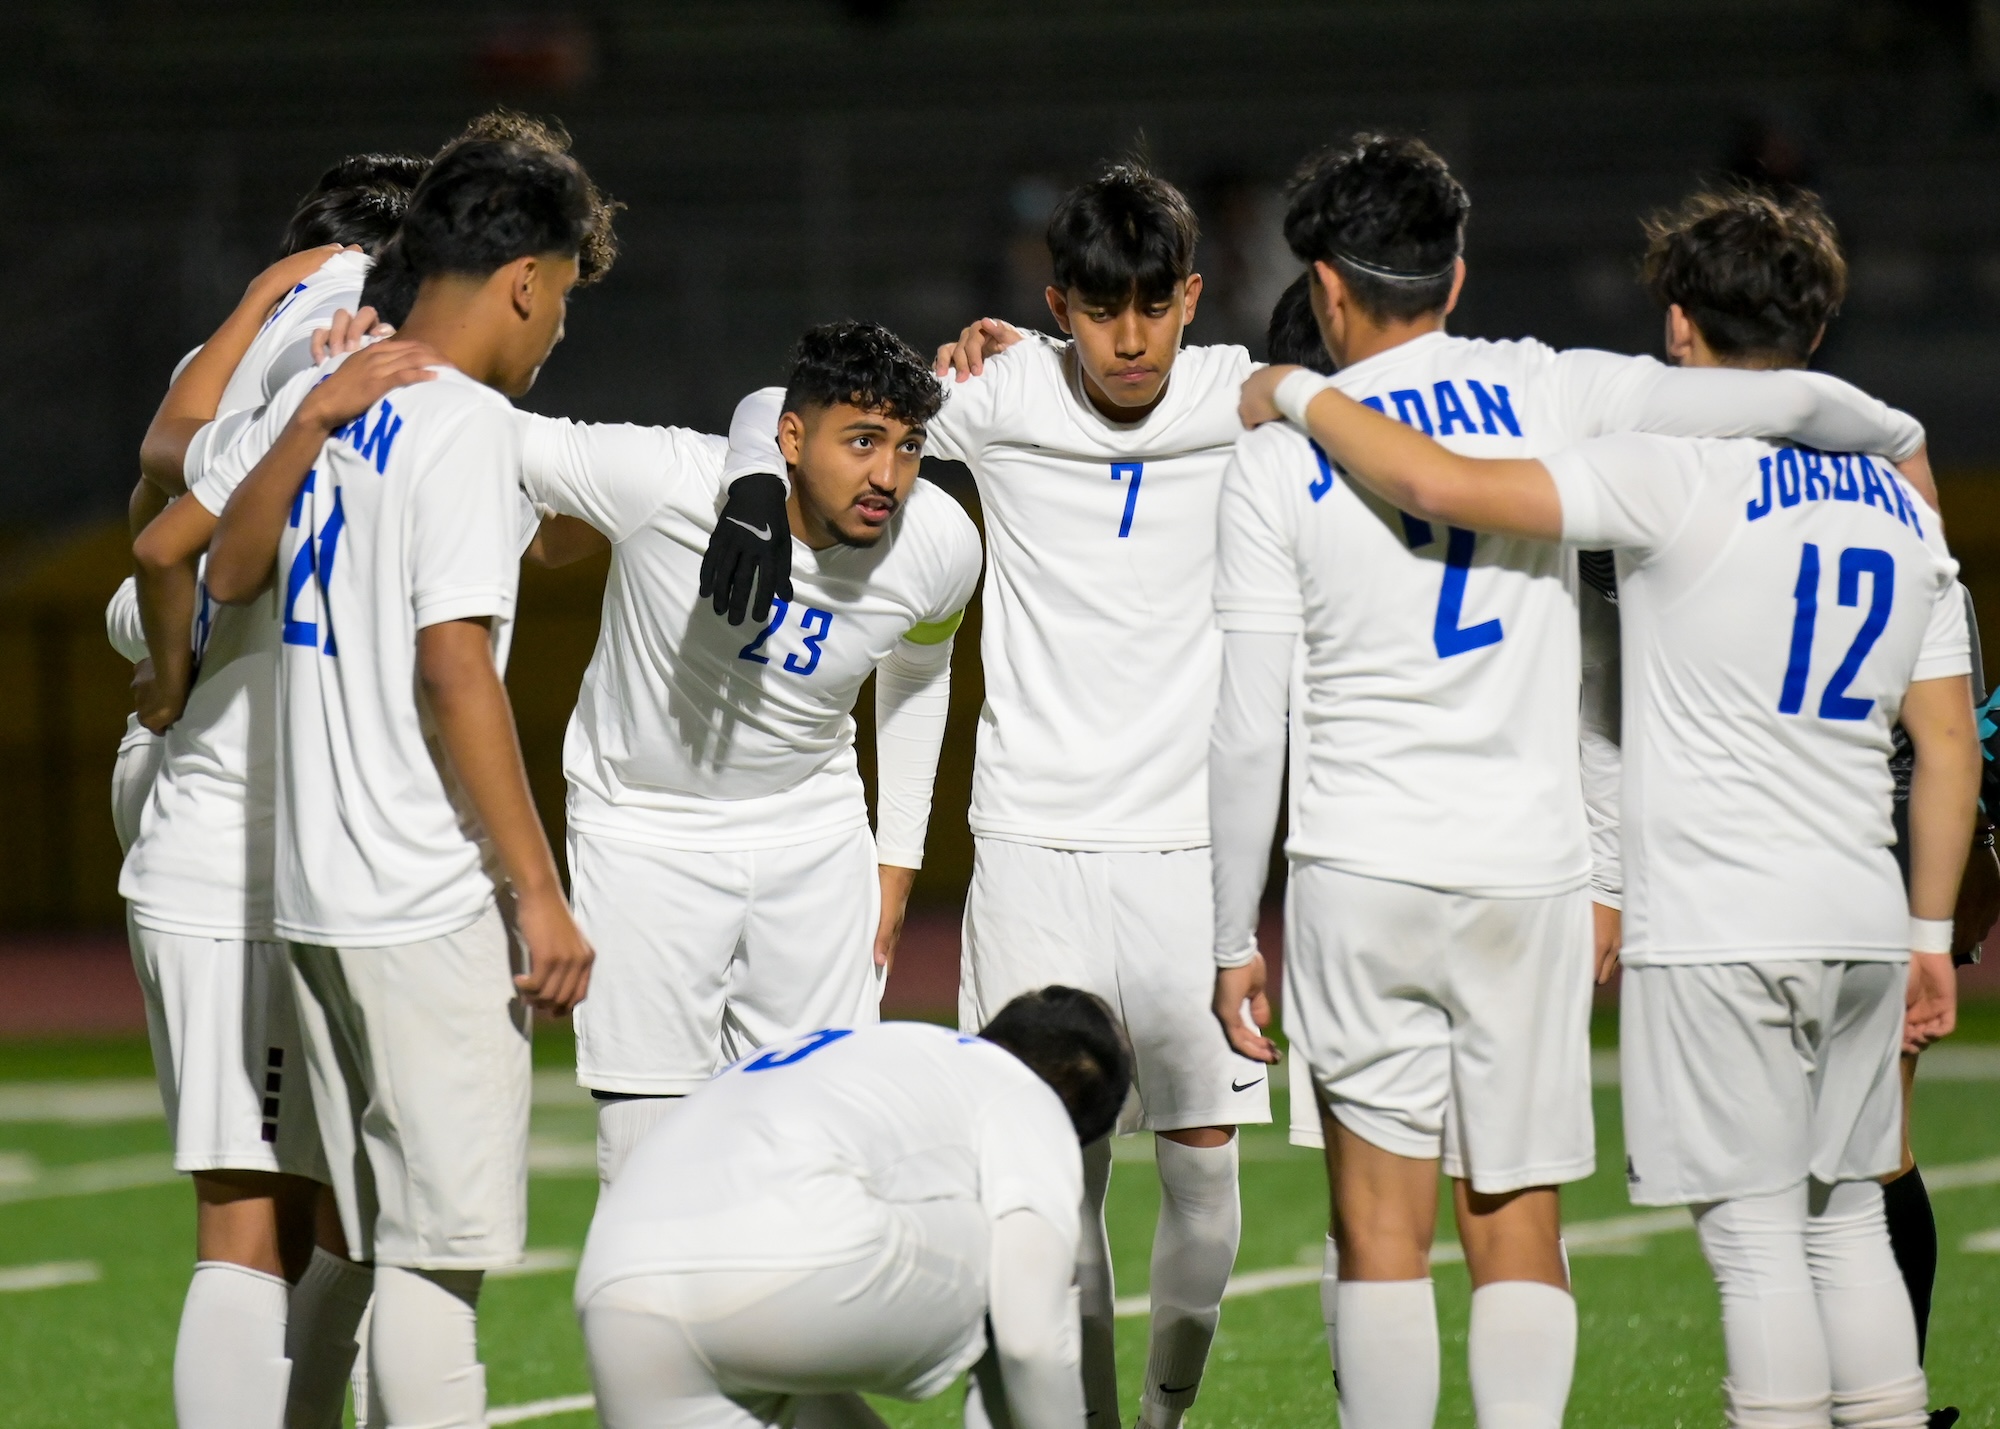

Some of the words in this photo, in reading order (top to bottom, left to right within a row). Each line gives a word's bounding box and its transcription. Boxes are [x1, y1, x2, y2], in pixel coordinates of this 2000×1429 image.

[1110, 462, 1144, 538] 7
[1746, 446, 1926, 539] JORDAN
[1401, 510, 1504, 660] 2
[738, 597, 834, 676] 23
[1777, 542, 1896, 722] 12
